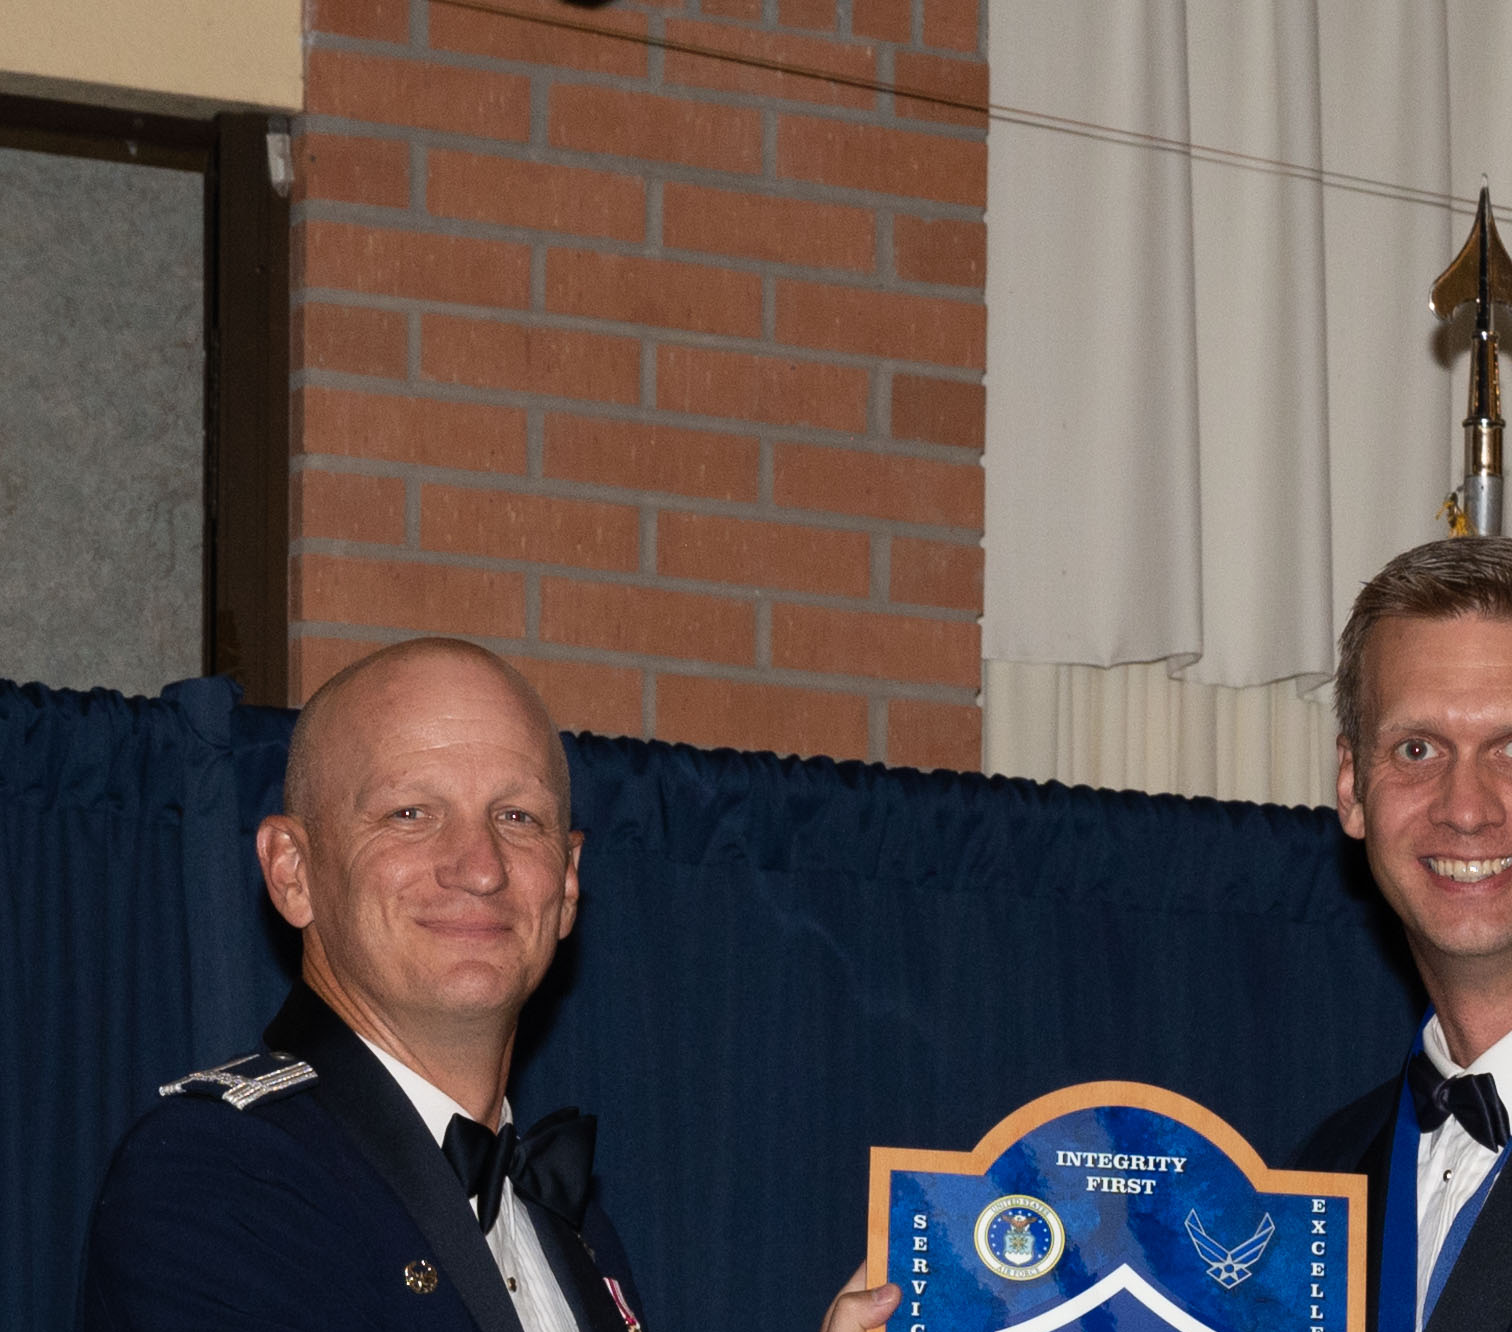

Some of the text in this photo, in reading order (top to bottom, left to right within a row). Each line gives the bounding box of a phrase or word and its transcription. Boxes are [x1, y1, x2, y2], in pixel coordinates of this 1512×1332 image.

[1055, 1150, 1187, 1173] INTEGRITY
[1085, 1175, 1157, 1195] FIRST
[991, 1198, 1051, 1216] UNITED STATES
[997, 1266, 1039, 1278] AIR FORCE
